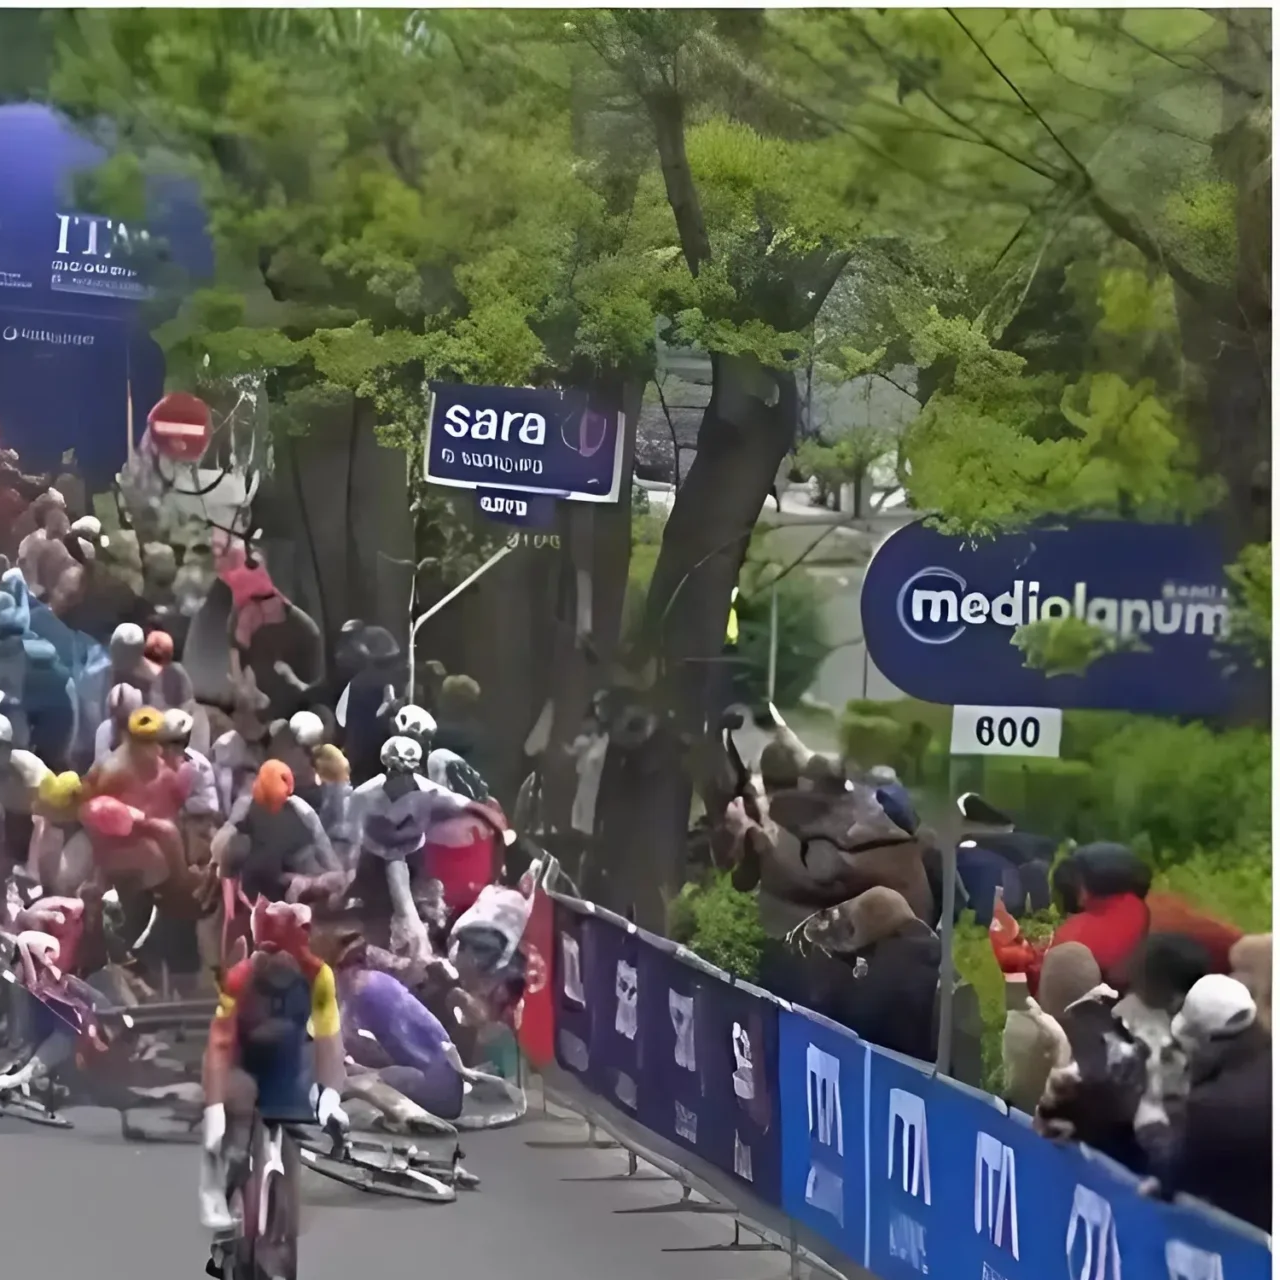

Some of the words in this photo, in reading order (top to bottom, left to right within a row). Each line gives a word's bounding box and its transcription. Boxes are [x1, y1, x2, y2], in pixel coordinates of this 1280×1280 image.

[444, 404, 546, 445] sara
[911, 580, 1230, 637] mediolanum
[976, 716, 1041, 748] 600
